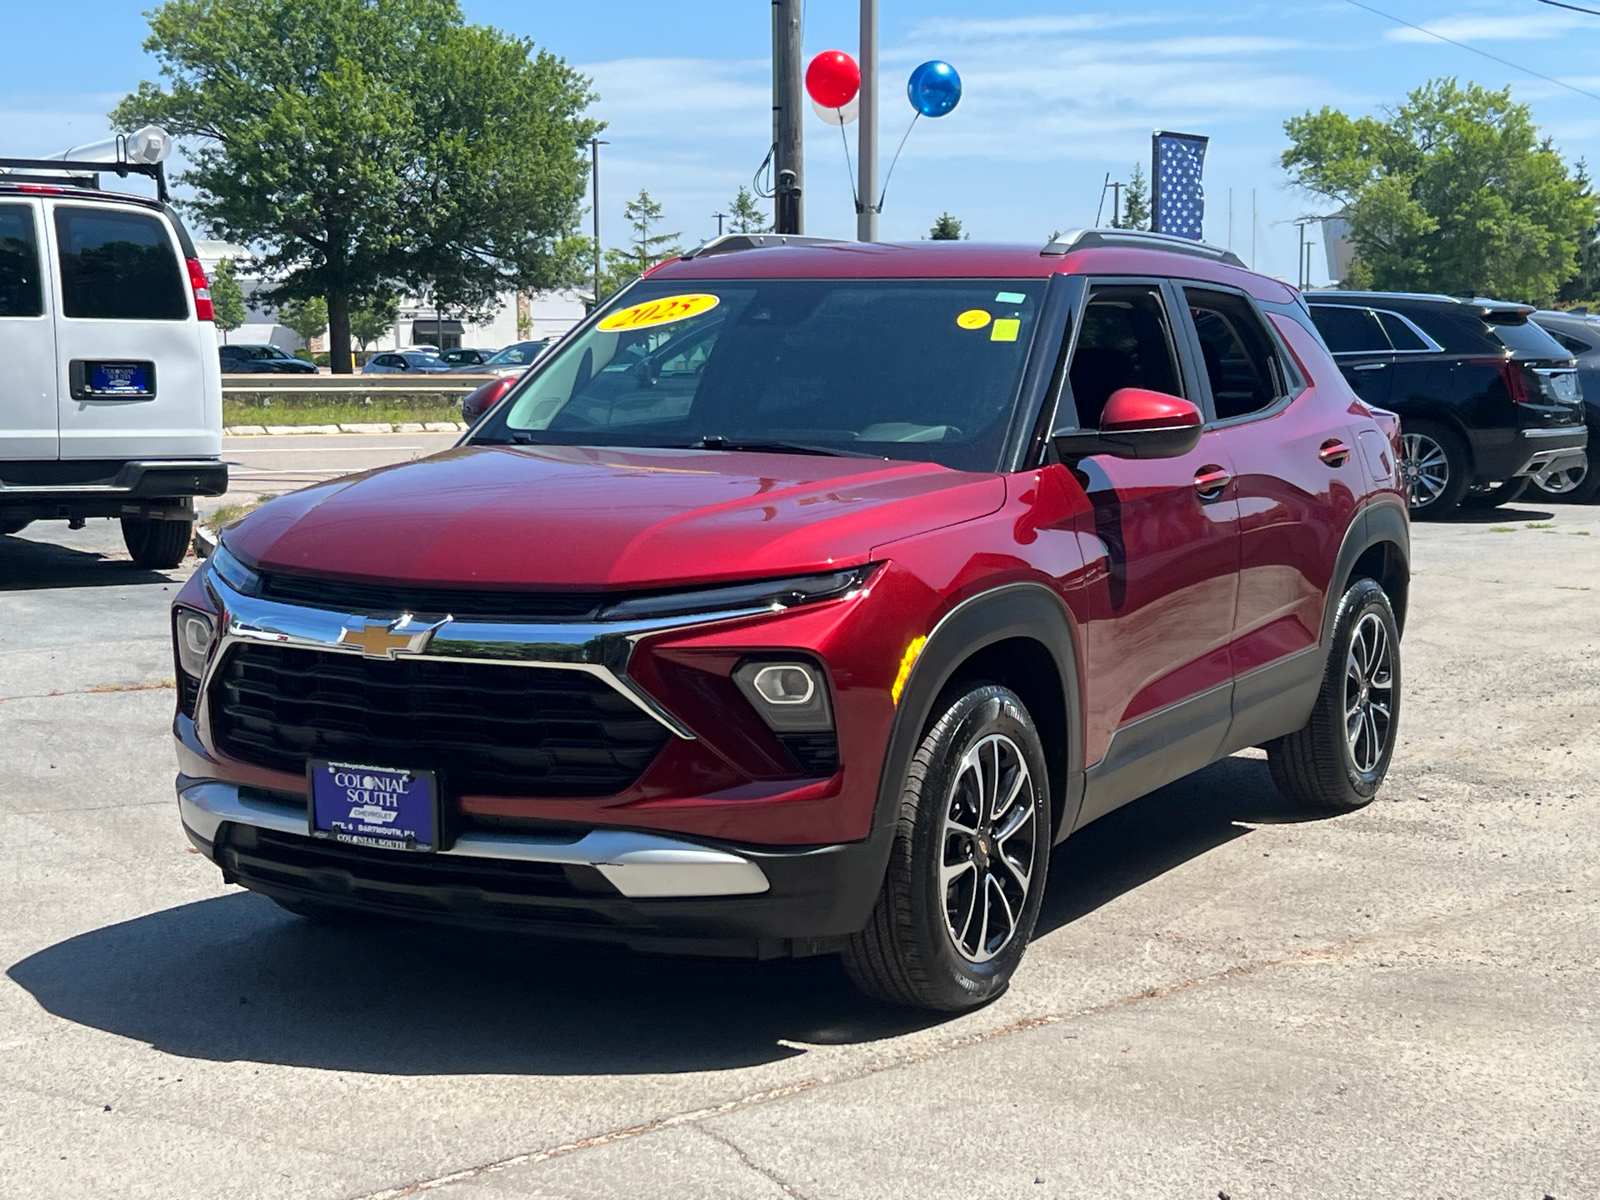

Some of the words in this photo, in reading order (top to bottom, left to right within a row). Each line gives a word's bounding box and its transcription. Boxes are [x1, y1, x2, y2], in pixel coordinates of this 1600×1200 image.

[611, 297, 701, 328] 2025
[335, 772, 410, 794] COLONIAL
[346, 789, 398, 807] SOUTH
[353, 808, 393, 820] CHEVROLET
[337, 833, 379, 846] COLONIAL
[379, 840, 406, 850] SOUTH
